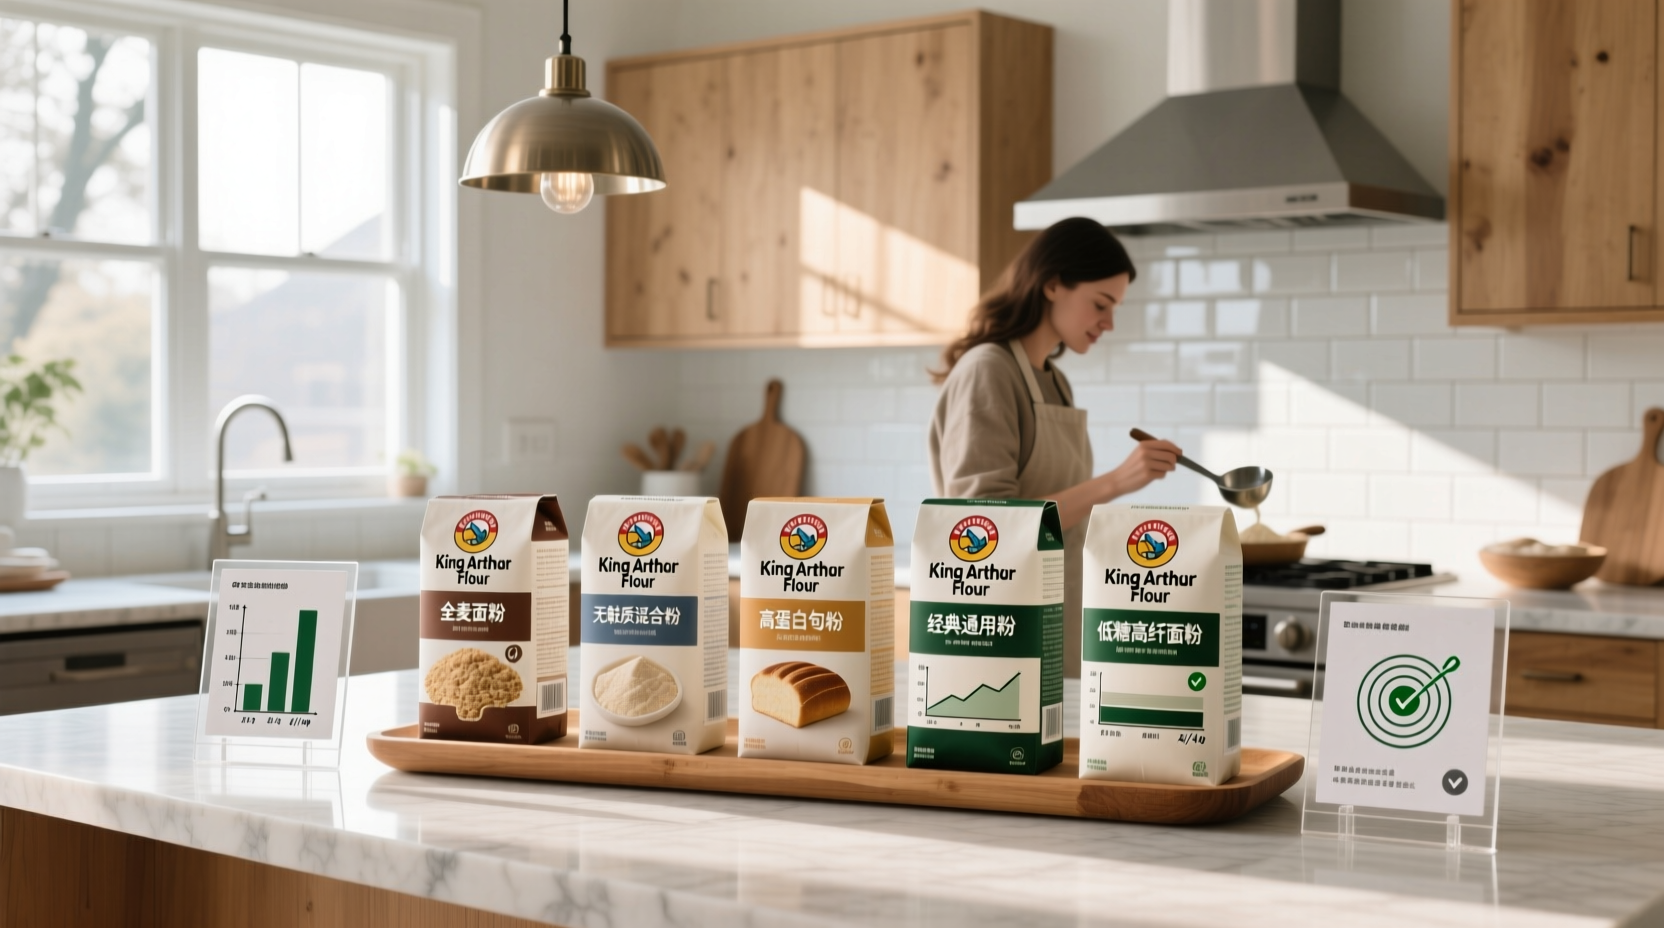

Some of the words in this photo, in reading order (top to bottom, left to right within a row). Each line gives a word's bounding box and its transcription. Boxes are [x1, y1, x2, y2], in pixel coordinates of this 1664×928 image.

[435, 554, 465, 573] King
[598, 557, 631, 575] King
[760, 560, 794, 578] King
[929, 562, 964, 583] King
[457, 570, 490, 585] Flour
[621, 573, 656, 588] Flour
[783, 578, 820, 593] Flour
[1105, 568, 1141, 590] King
[952, 580, 990, 596] Flour
[1130, 587, 1171, 603] Flour
[440, 601, 506, 623] 全麦面粉
[927, 613, 1016, 637] 经典通用粉
[1097, 620, 1203, 645] 低糖高纤面粉
